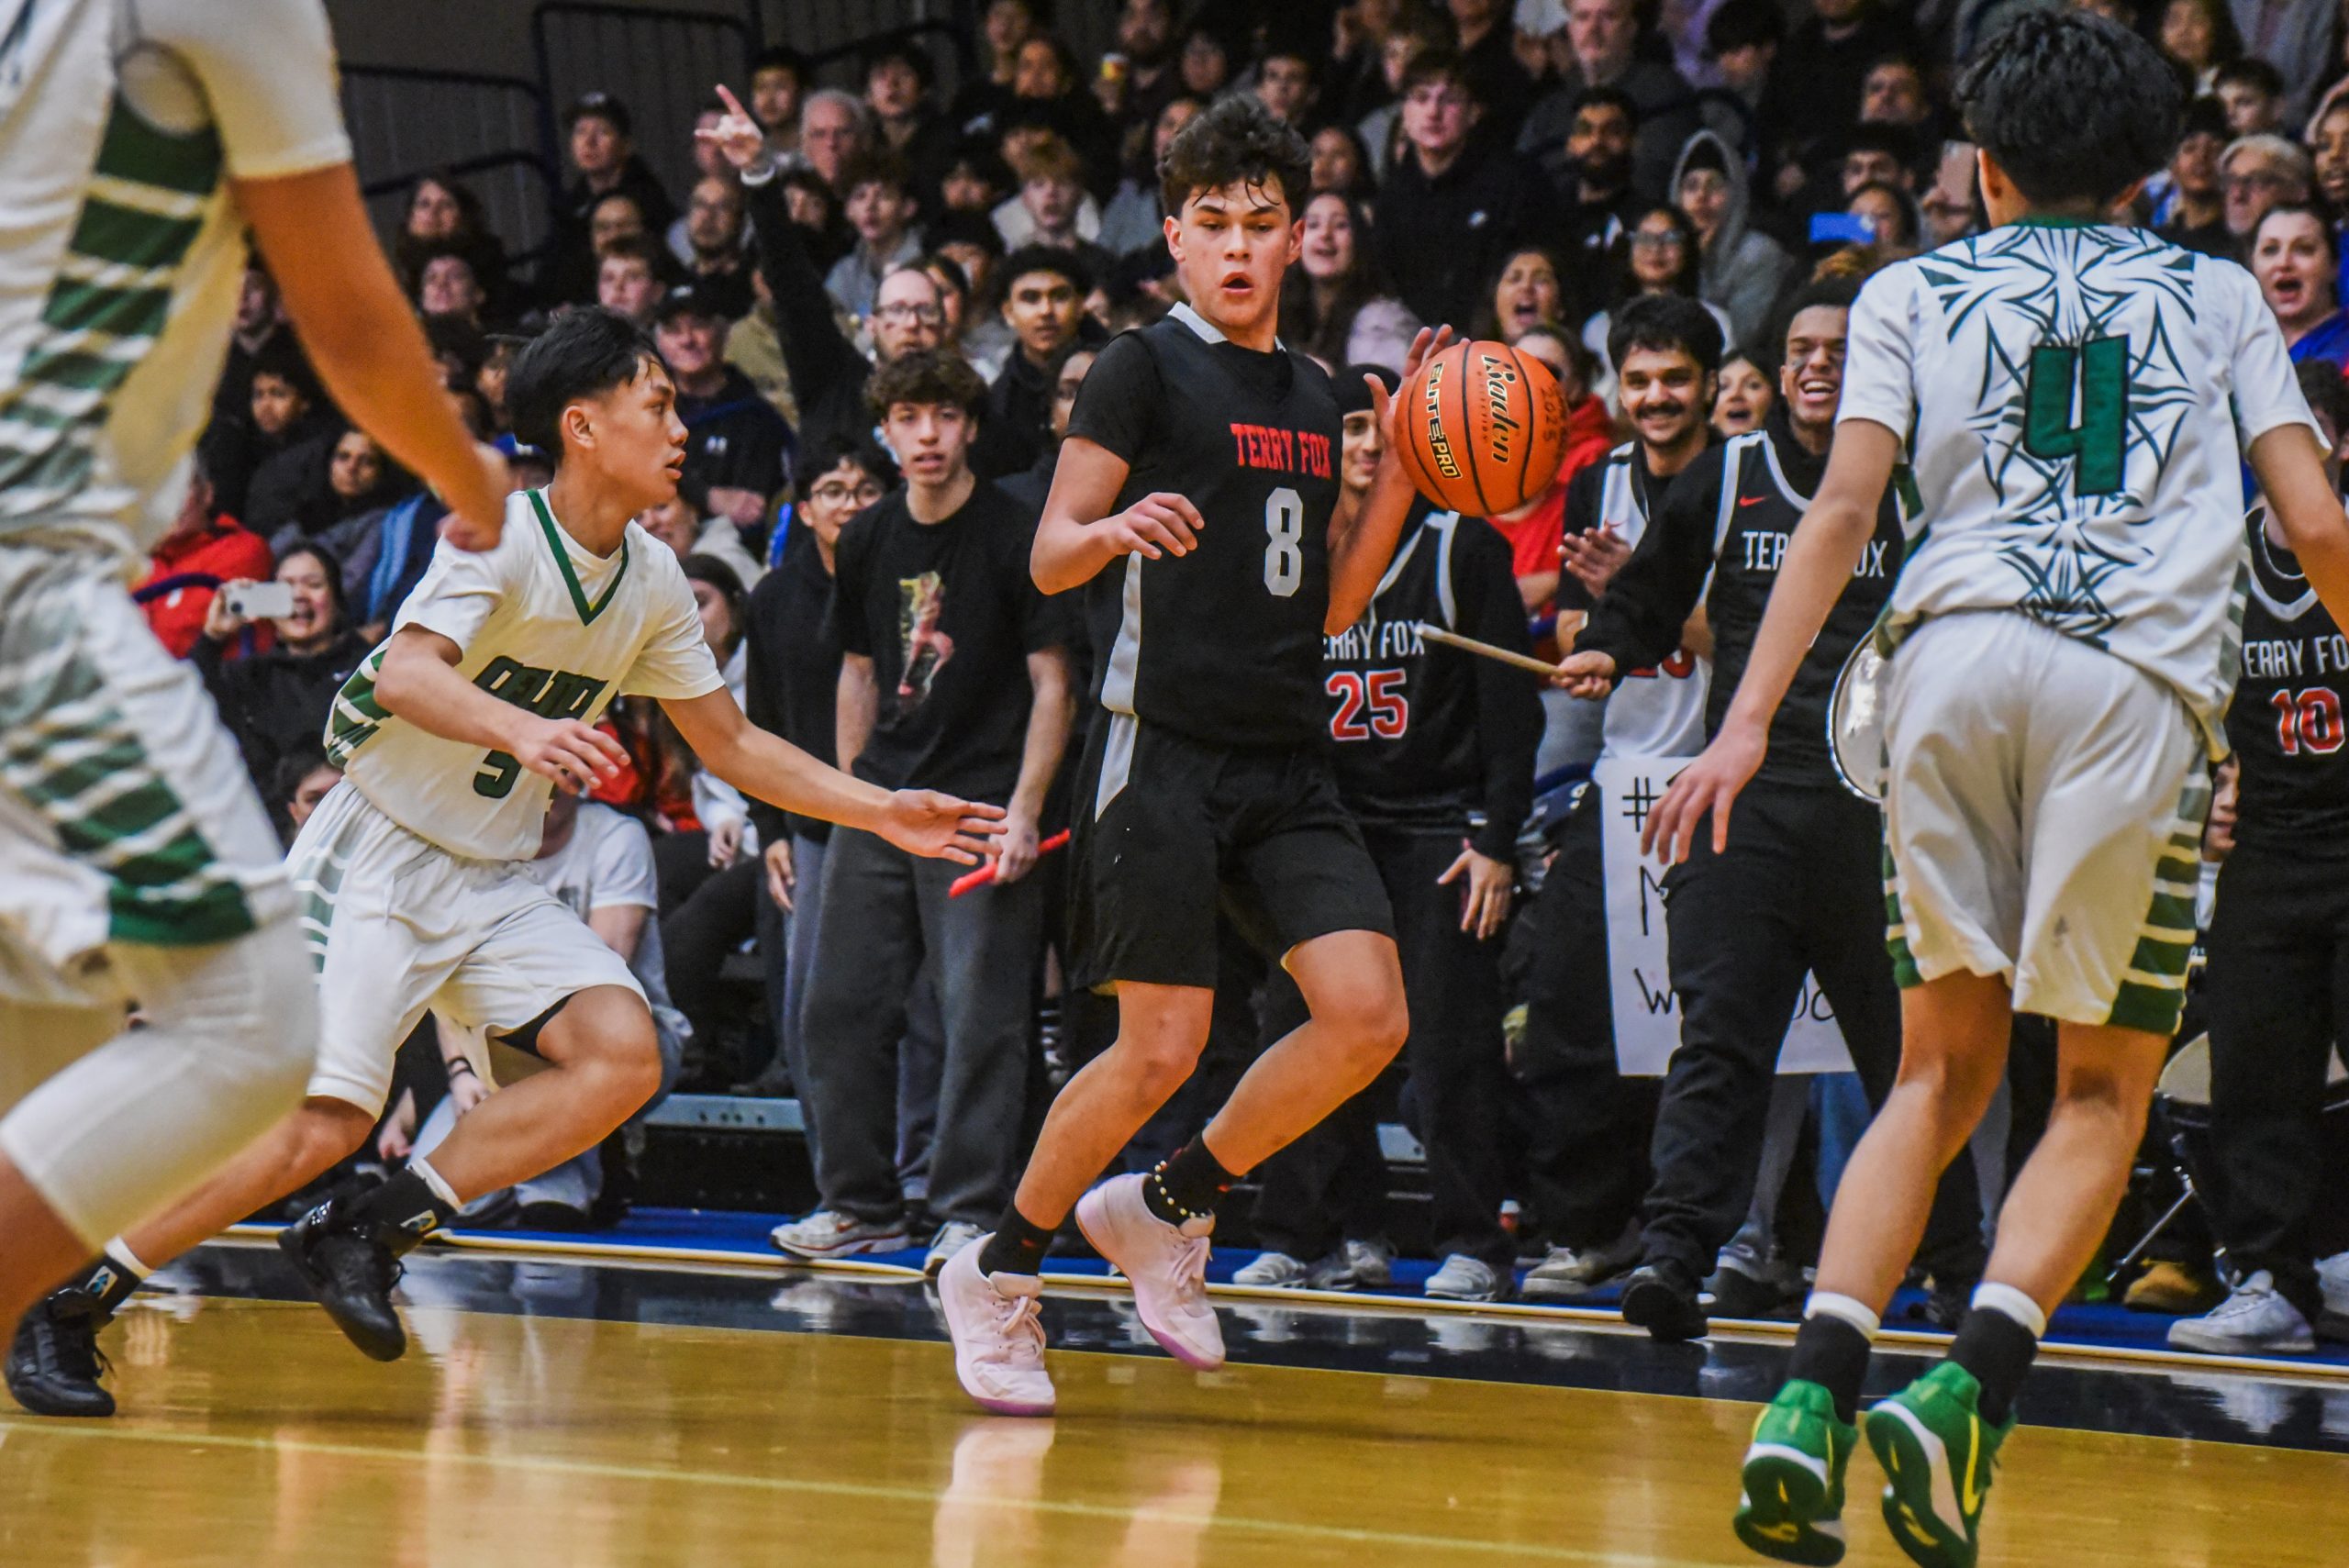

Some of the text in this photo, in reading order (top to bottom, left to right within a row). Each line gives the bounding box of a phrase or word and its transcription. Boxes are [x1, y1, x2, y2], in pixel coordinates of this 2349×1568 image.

[1426, 361, 1462, 479] ELITE PRO
[1482, 354, 1520, 463] Baden
[2023, 334, 2130, 497] 4
[1230, 423, 1331, 479] TERRY FOX
[1264, 486, 1304, 596] 8
[1742, 530, 1789, 571] TER
[1323, 619, 1424, 660] RRY FOX
[2243, 633, 2349, 678] ERRY FO
[1325, 667, 1408, 741] 25
[2270, 687, 2345, 755] 10
